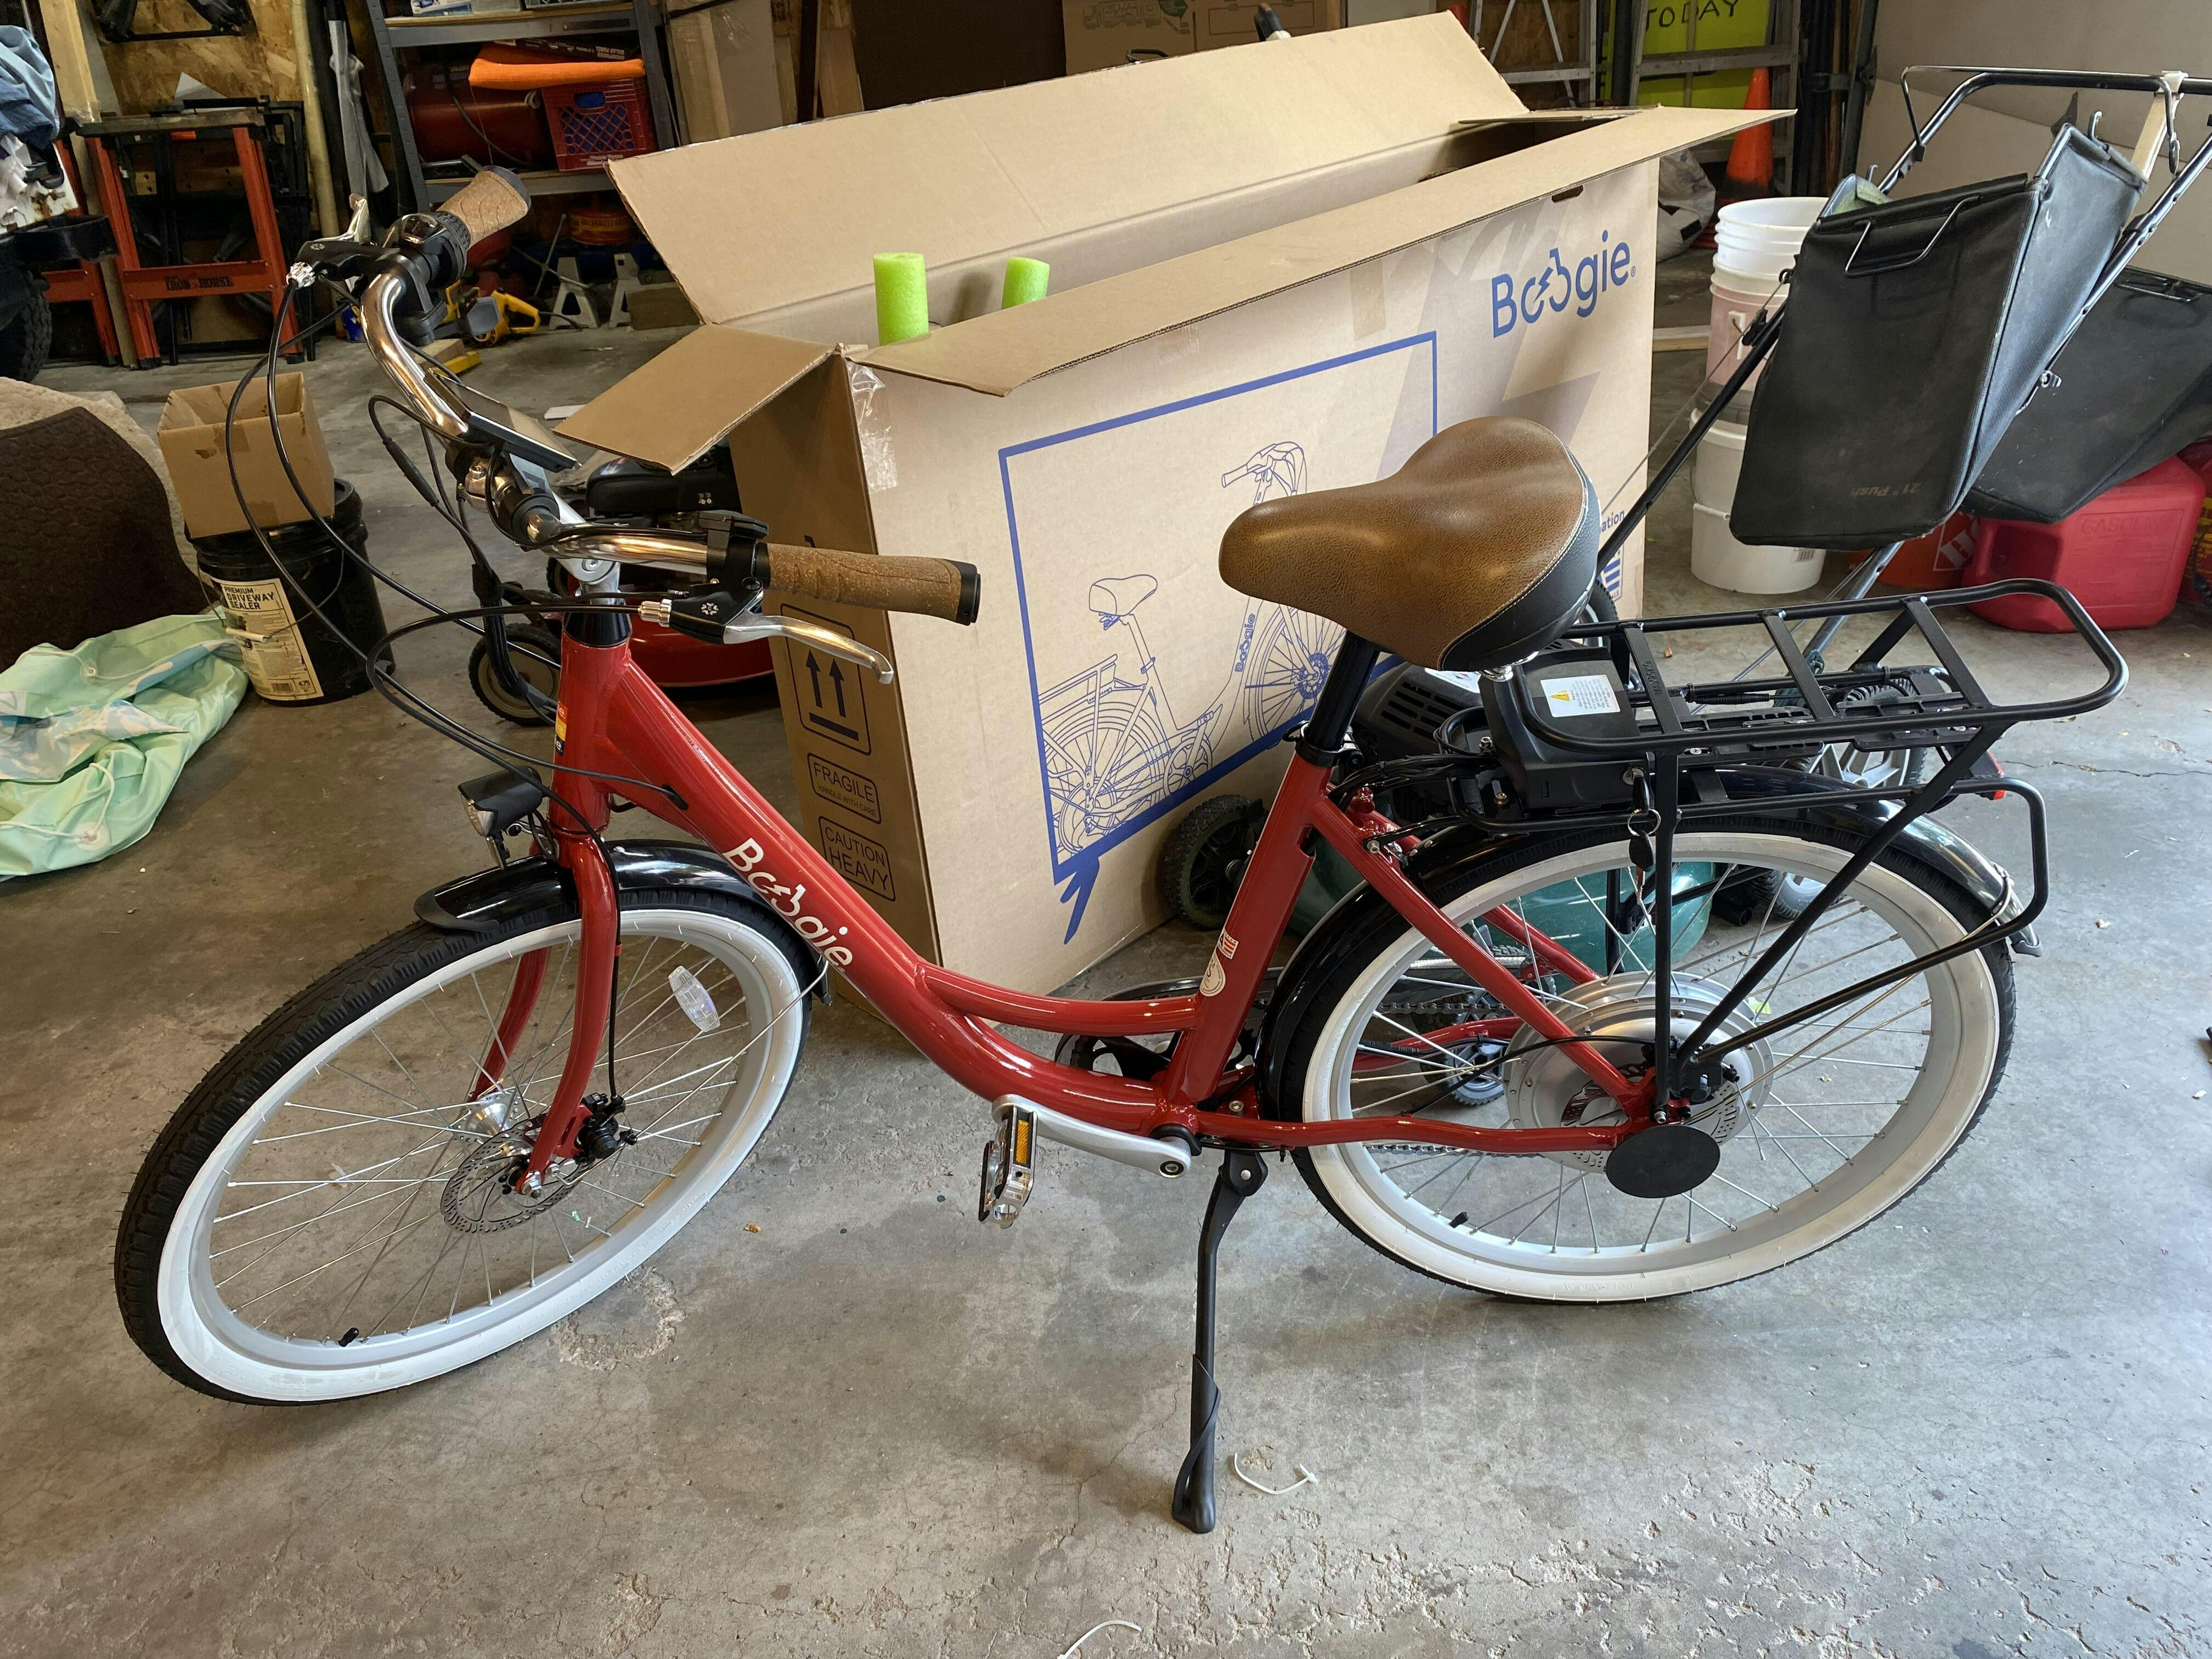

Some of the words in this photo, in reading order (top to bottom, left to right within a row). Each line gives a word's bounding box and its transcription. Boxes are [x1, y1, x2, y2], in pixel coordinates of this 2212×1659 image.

[1645, 0, 1739, 31] TODAY
[224, 586, 254, 594] PREMIUM
[226, 591, 274, 602] DRIVEWAY
[230, 600, 262, 610] SEALER
[813, 761, 875, 803] FRAGILE
[817, 783, 842, 801] HANDLE
[842, 793, 858, 809] WITH
[859, 802, 878, 818] CARE
[825, 826, 885, 867] CAUTION
[829, 846, 889, 891] HEAVY
